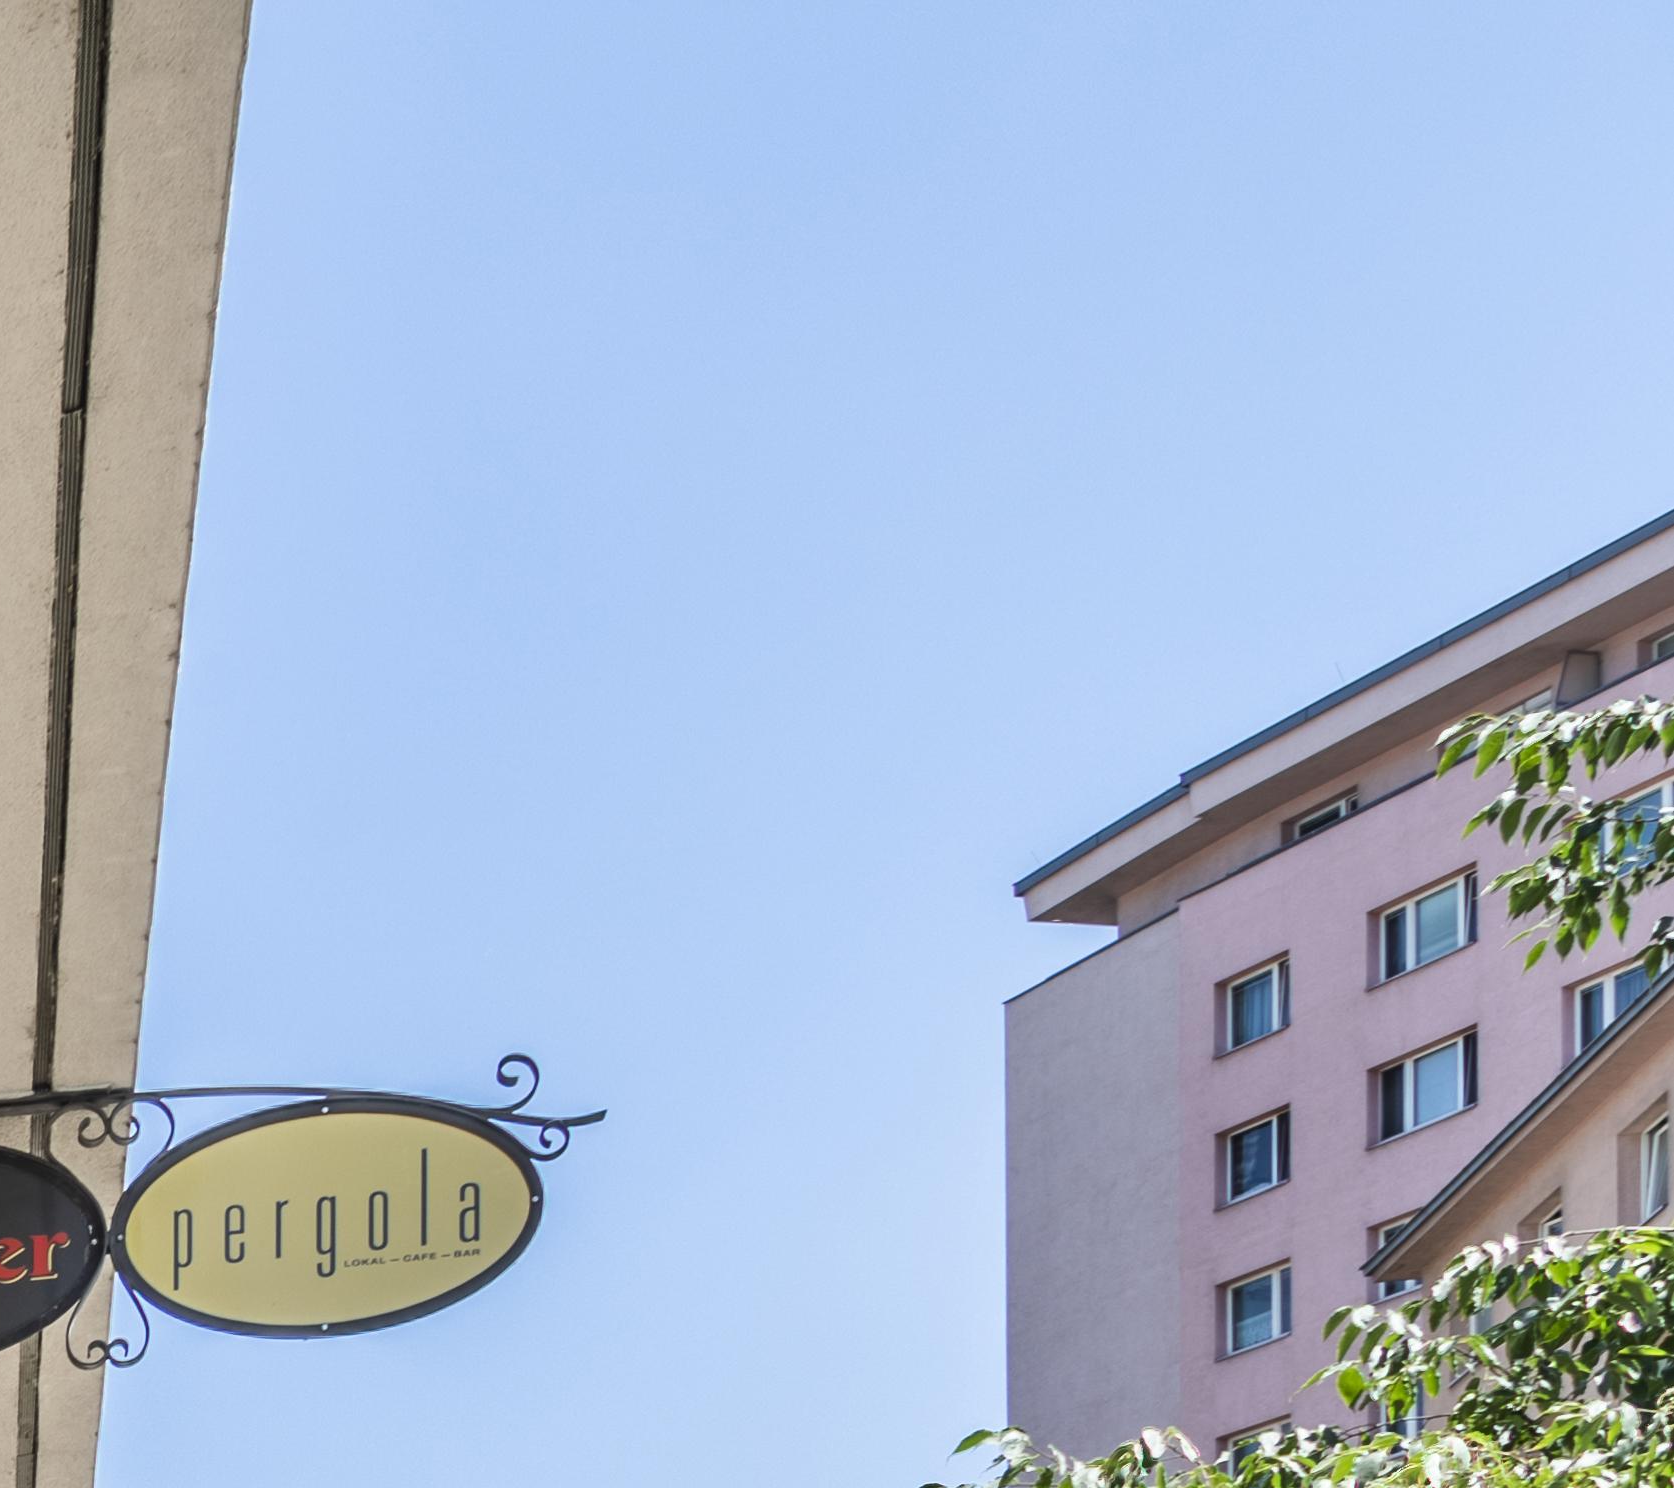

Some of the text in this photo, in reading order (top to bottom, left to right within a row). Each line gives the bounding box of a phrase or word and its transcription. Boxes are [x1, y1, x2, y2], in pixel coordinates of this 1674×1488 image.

[172, 1147, 481, 1291] pergola
[343, 1256, 386, 1268] LOKAL
[453, 1249, 481, 1259] BAR
